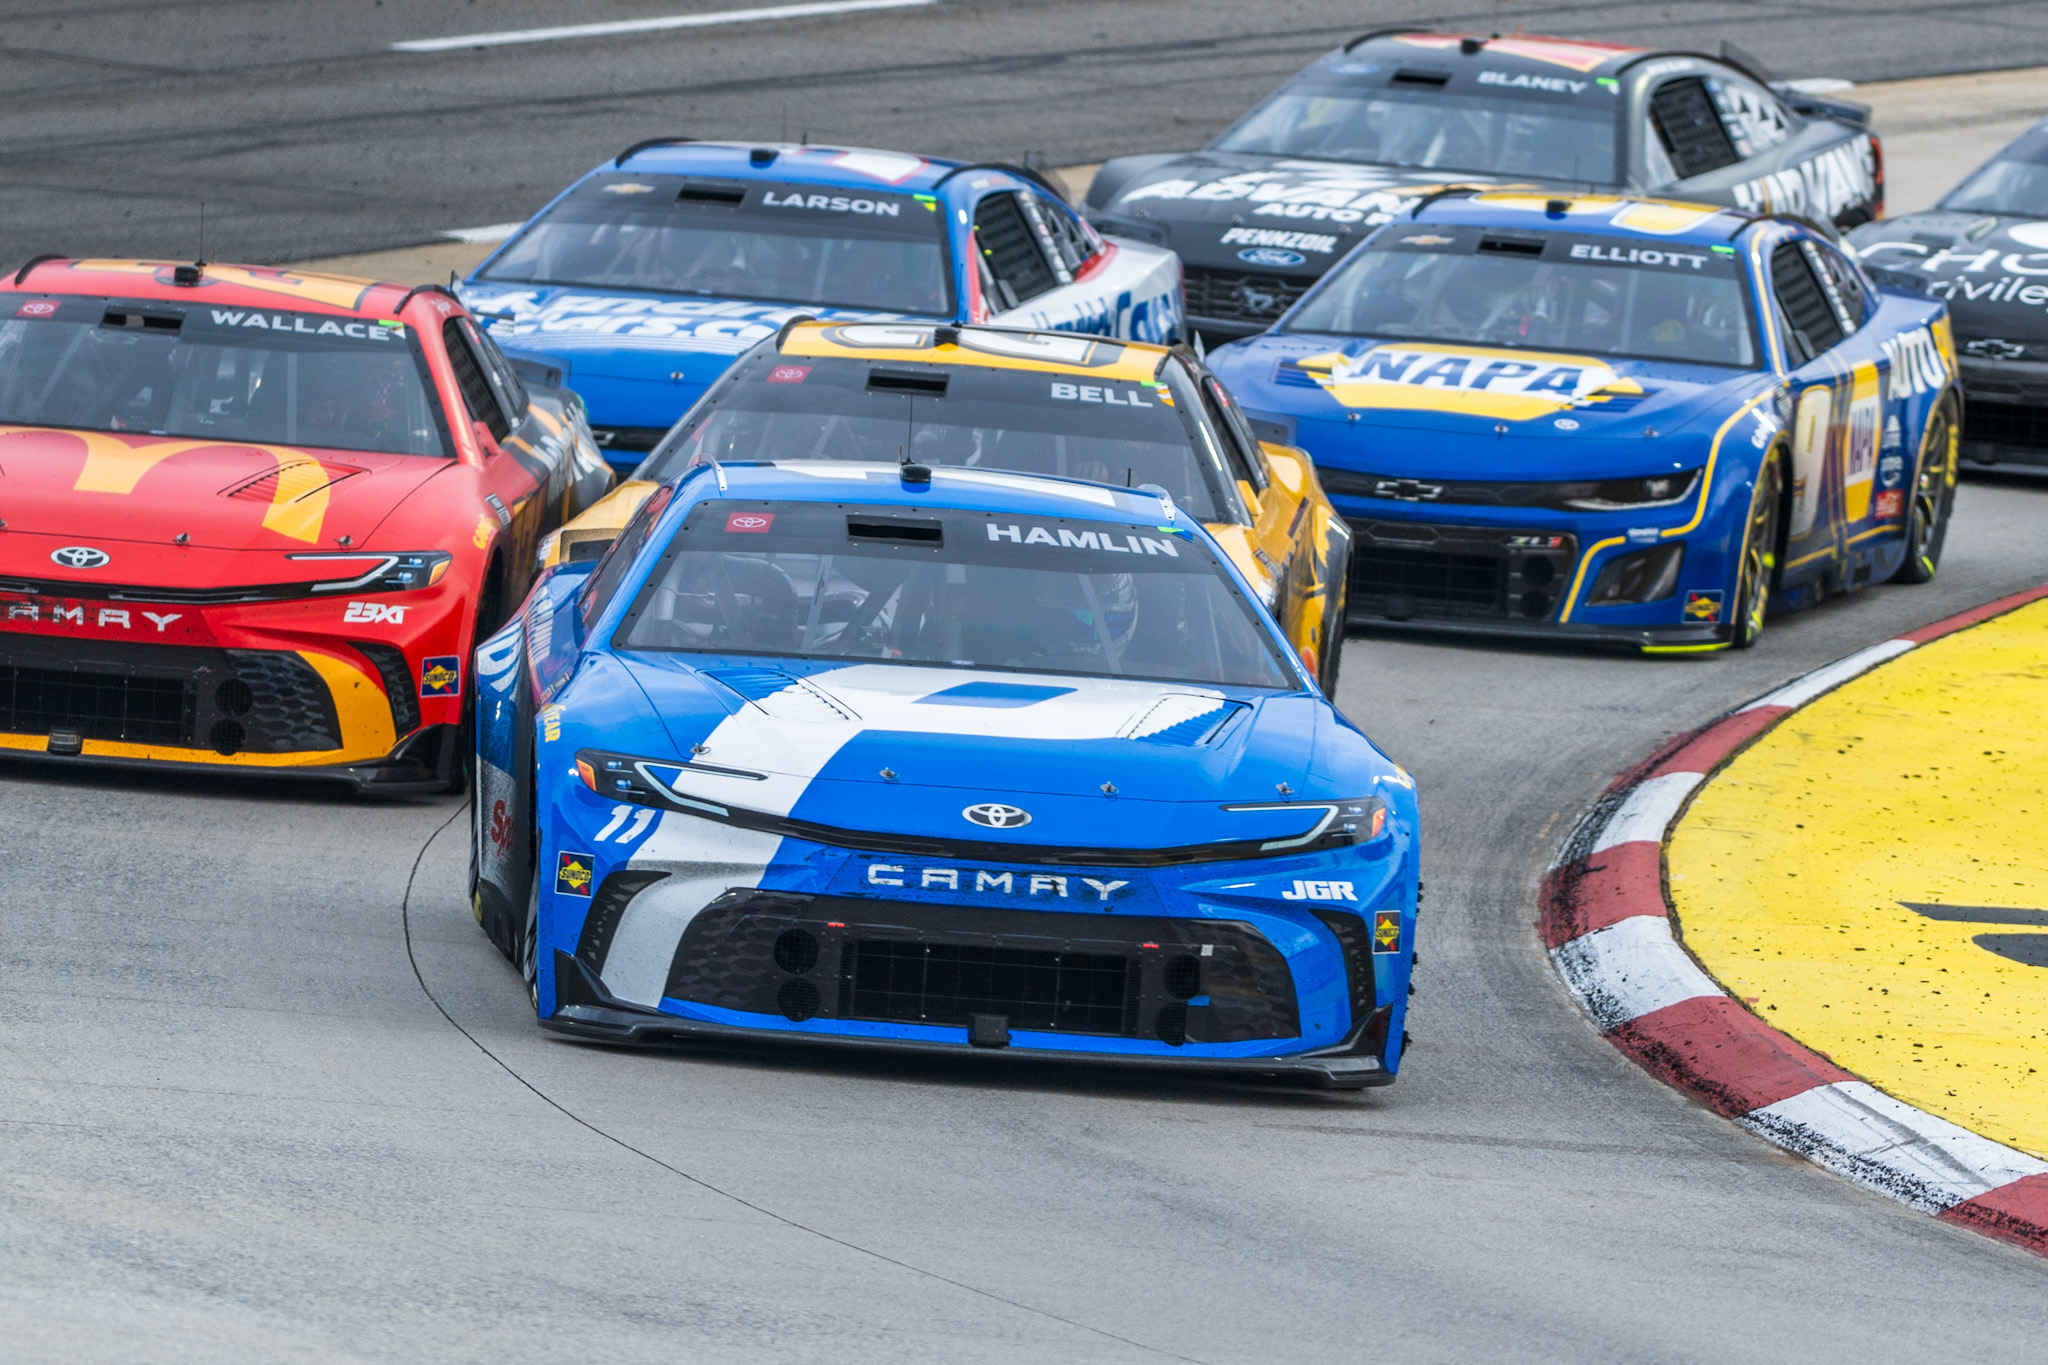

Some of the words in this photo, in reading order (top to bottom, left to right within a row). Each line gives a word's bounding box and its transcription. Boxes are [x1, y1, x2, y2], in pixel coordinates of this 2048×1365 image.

[1477, 71, 1588, 95] BLANEY
[762, 191, 900, 217] LARSON
[1252, 203, 1364, 223] AUTO
[1220, 227, 1339, 254] PENNZOIL
[1569, 243, 1708, 271] ELLIOTT
[1926, 275, 2048, 305] rivile
[210, 309, 391, 341] WALLACE
[1347, 351, 1584, 396] NAPA
[1051, 382, 1154, 408] BELL
[985, 522, 1180, 558] HAMLIN
[424, 671, 456, 683] SUNOCO
[594, 804, 656, 845] 11
[561, 868, 591, 882] SUNOCO
[867, 862, 1130, 900] CAMRY
[1281, 879, 1359, 902] JGR
